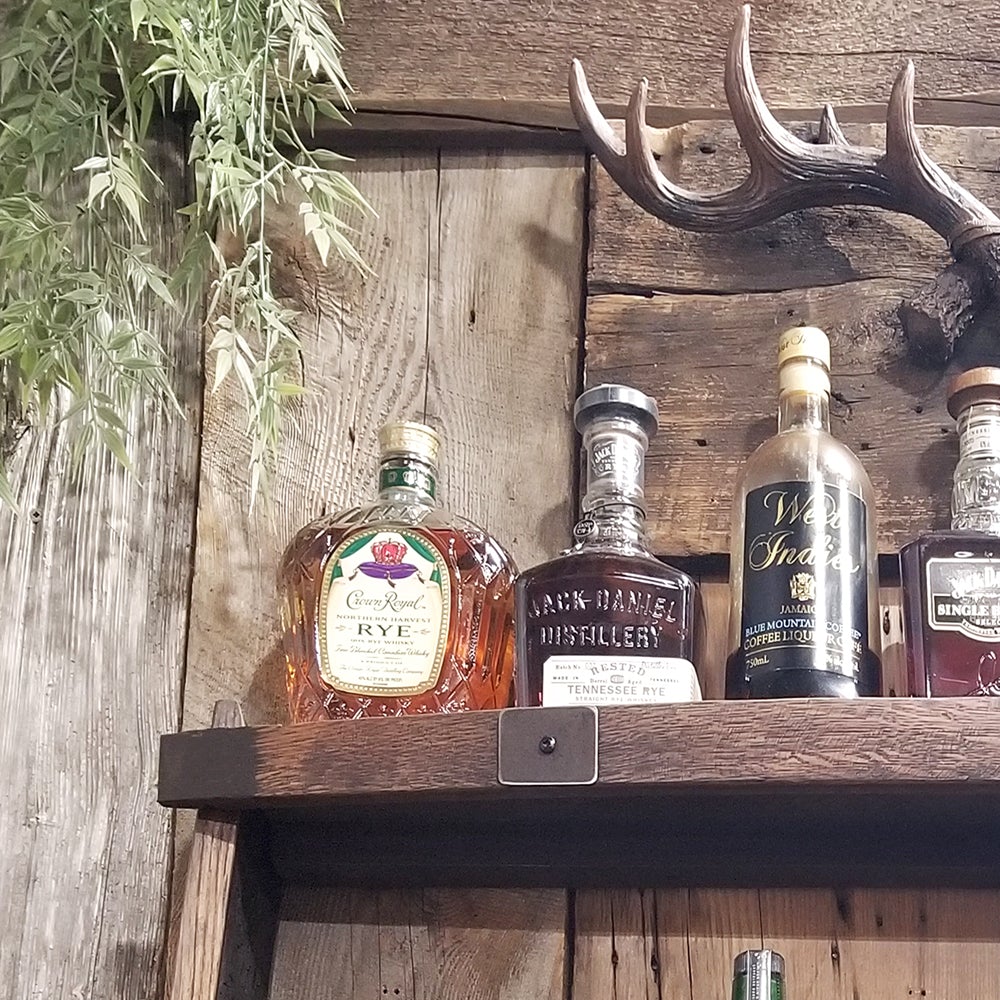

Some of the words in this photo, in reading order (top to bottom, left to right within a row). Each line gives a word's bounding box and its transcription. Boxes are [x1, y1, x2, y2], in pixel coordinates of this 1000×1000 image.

[764, 489, 845, 528] Wes
[346, 589, 382, 610] Crown
[373, 591, 425, 613] Royal
[529, 589, 586, 618] JACK
[596, 589, 677, 623] DANIEL
[780, 604, 820, 615] JAMAIC
[937, 603, 990, 617] SINGLE
[336, 614, 388, 622] NORTHERN
[357, 623, 412, 638] RYE
[745, 622, 766, 637] BLUE
[767, 618, 820, 631] MOUNTAI
[540, 624, 663, 648] DISTILLERY
[744, 631, 780, 650] COFFEE
[783, 630, 835, 647] LIQUR
[406, 647, 430, 657] Whisky
[590, 662, 647, 676] RESTED
[746, 655, 769, 670] 750mL
[568, 685, 638, 696] TENNESSEE
[642, 686, 666, 697] RYE
